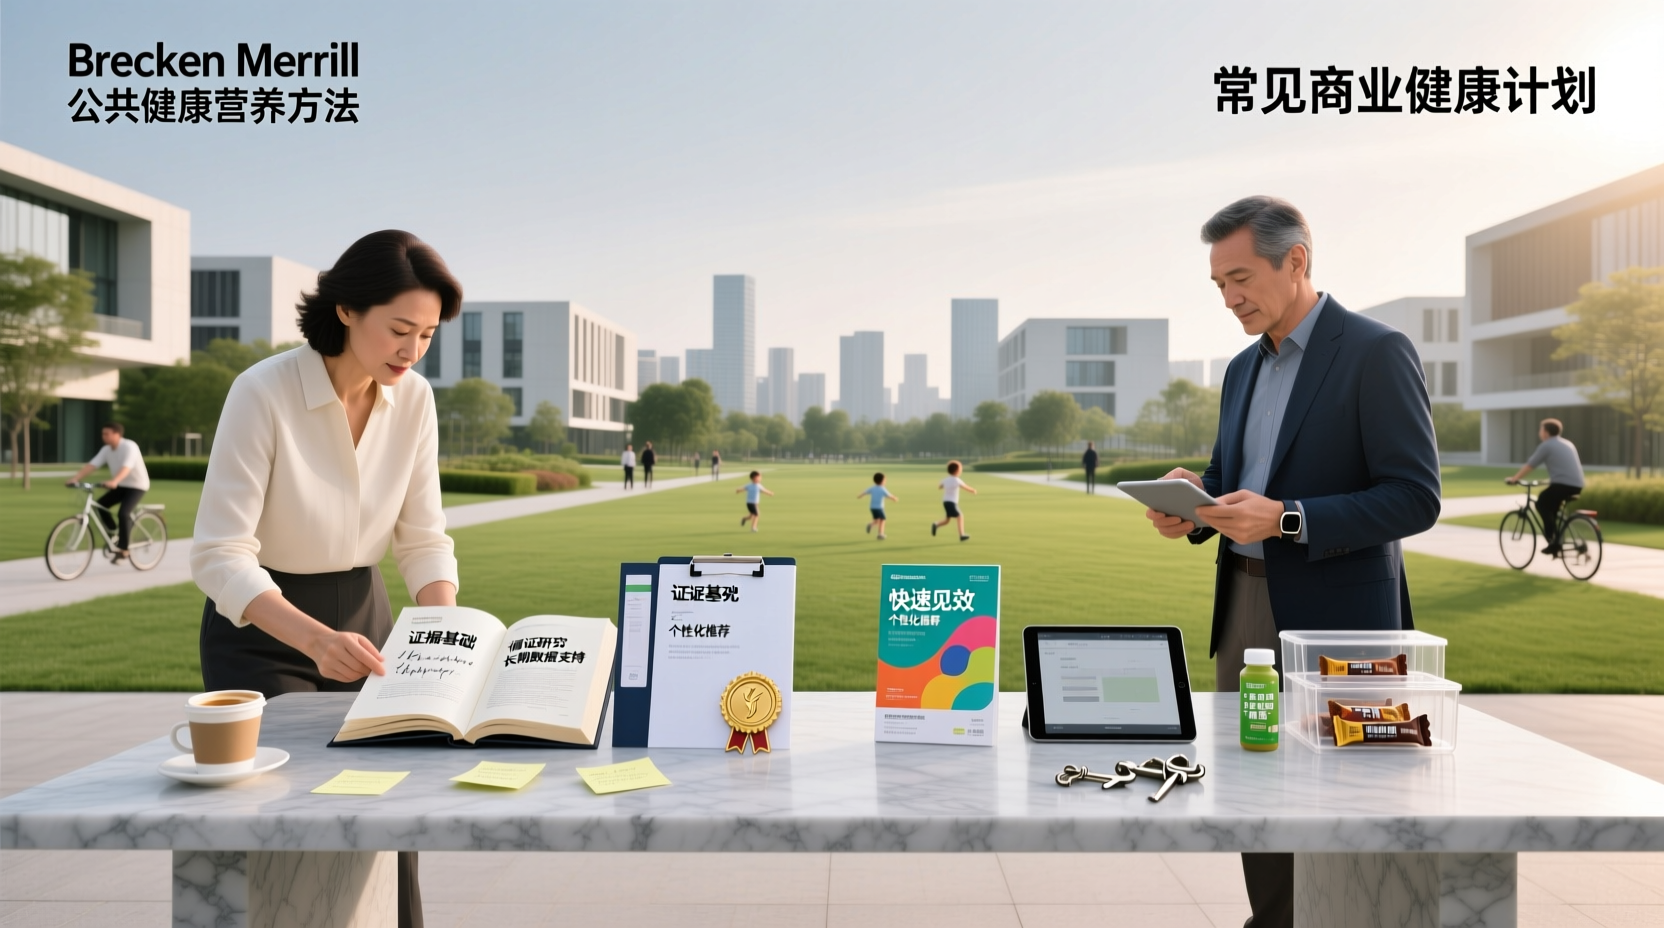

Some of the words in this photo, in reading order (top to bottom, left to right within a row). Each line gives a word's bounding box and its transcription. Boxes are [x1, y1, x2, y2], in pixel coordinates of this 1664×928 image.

[888, 587, 975, 612] 快速见效
[669, 623, 731, 639] 个性化推荐
